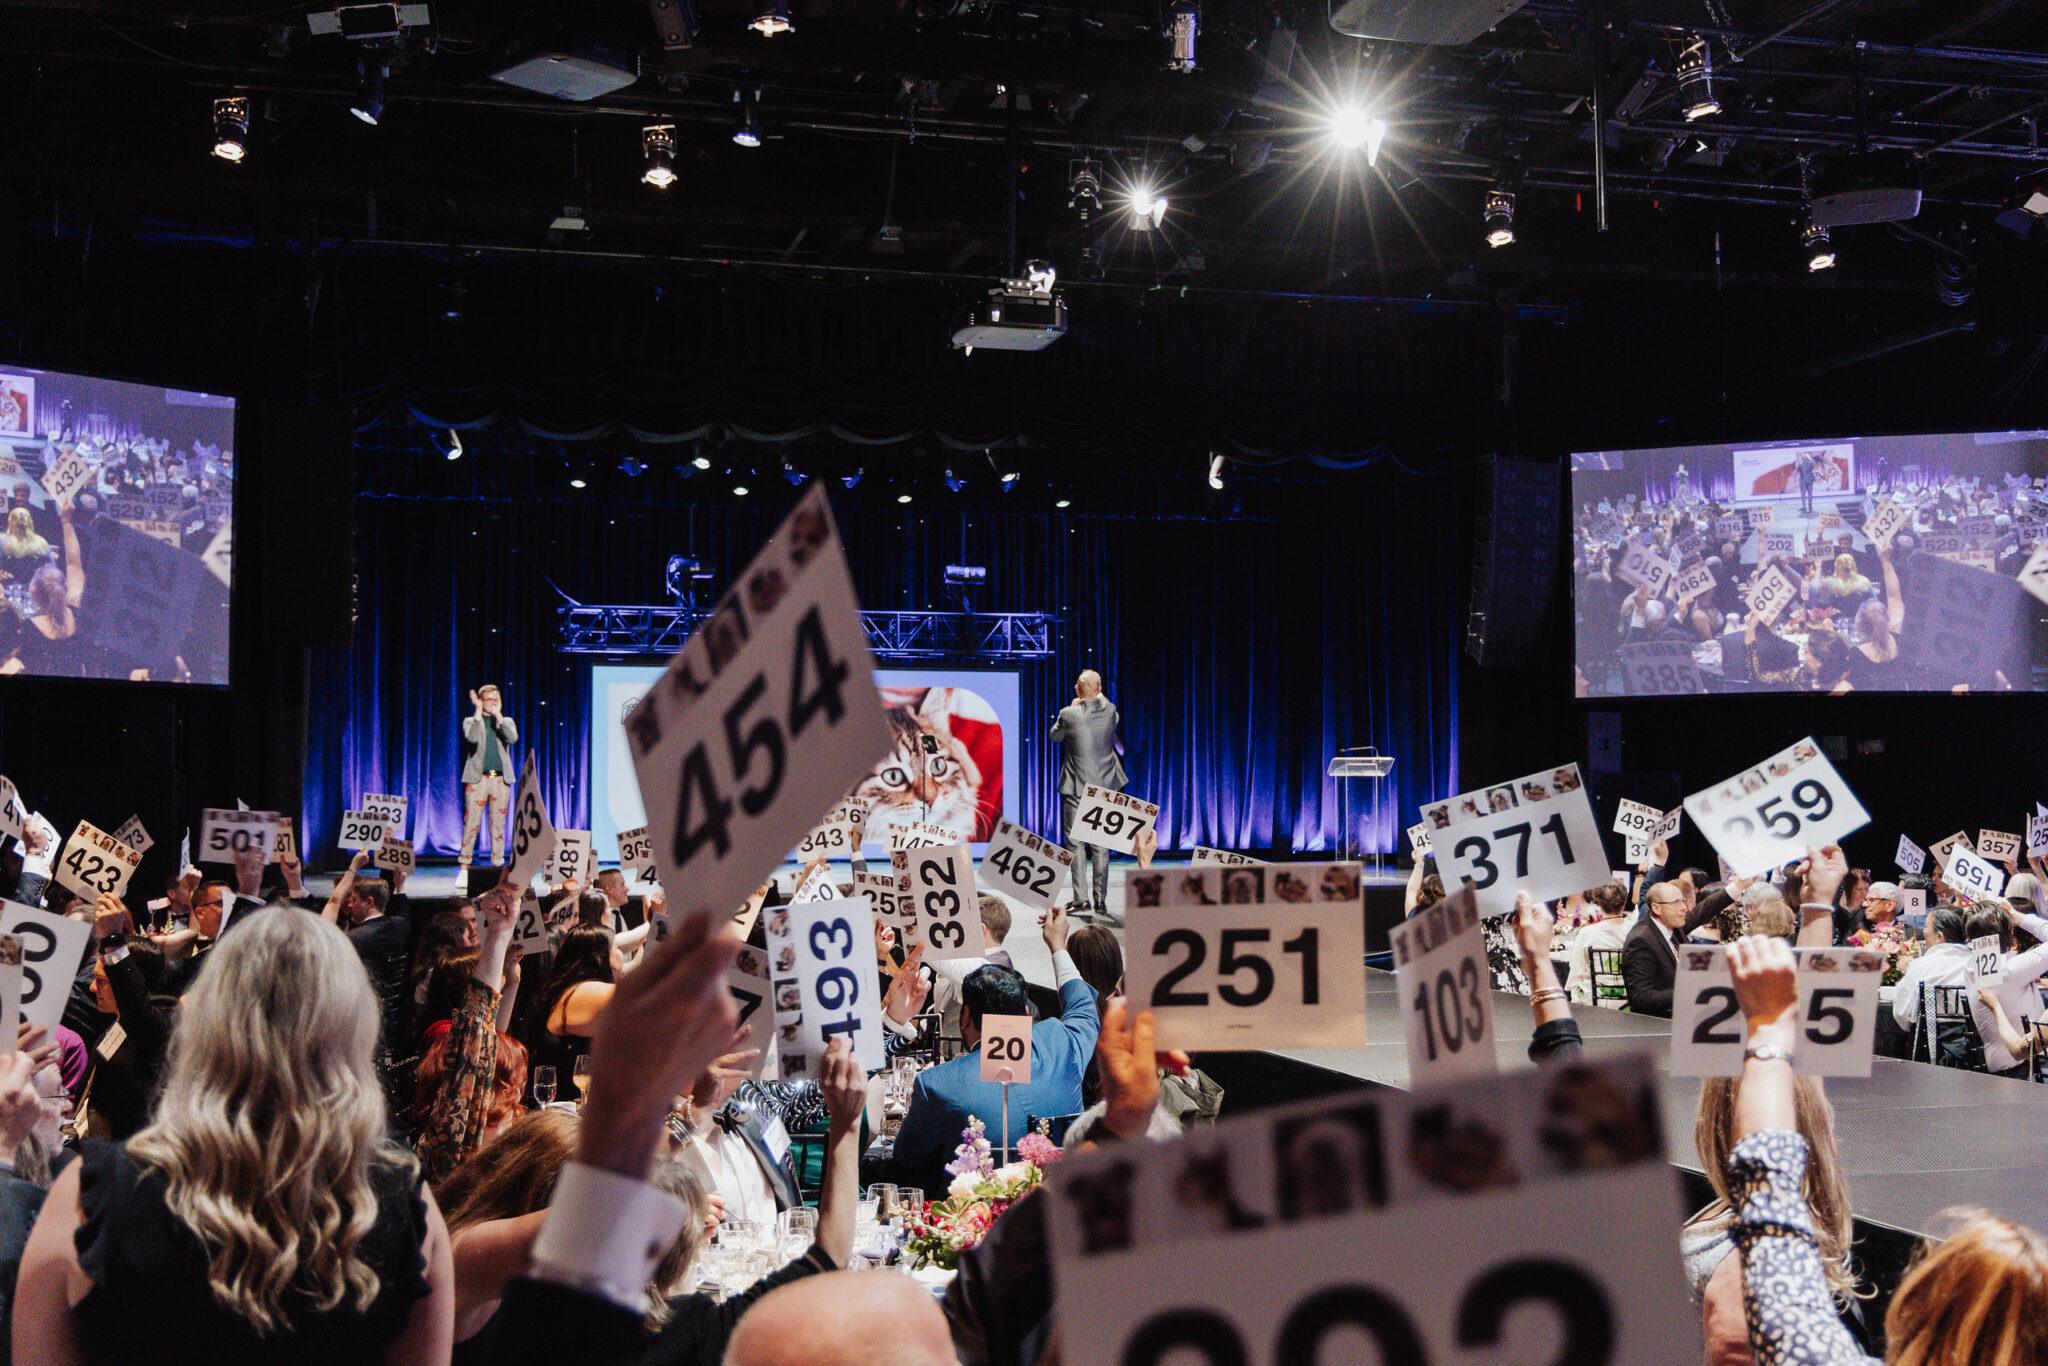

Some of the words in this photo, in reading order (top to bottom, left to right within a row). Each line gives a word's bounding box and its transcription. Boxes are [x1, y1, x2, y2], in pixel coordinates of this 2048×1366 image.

[54, 460, 84, 497] 432
[1719, 523, 1740, 532] 216
[1752, 513, 1770, 523] 215
[1873, 508, 1899, 540] 432
[1767, 541, 1792, 551] 202
[1810, 546, 1832, 557] 489
[1627, 553, 1663, 584] 510
[1680, 571, 1709, 593] 464
[672, 604, 849, 869] 454
[345, 823, 382, 842] 290
[1082, 806, 1146, 842] 497
[1621, 813, 1655, 832] 492
[210, 828, 266, 853] 501
[274, 832, 291, 853] 87
[800, 828, 844, 852] 343
[1454, 813, 1577, 890] 371
[1982, 839, 2015, 855] 357
[378, 847, 411, 866] 289
[559, 838, 580, 879] 481
[1900, 850, 1920, 872] 505
[66, 847, 122, 895] 423
[990, 845, 1056, 898] 462
[920, 856, 965, 949] 332
[1911, 897, 1919, 907] 8
[1150, 927, 1320, 1007] 251
[1976, 953, 1998, 977] 122
[808, 917, 862, 1052] 493
[1414, 955, 1484, 1062] 103
[1691, 986, 1855, 1045] 25
[987, 1036, 1025, 1061] 20
